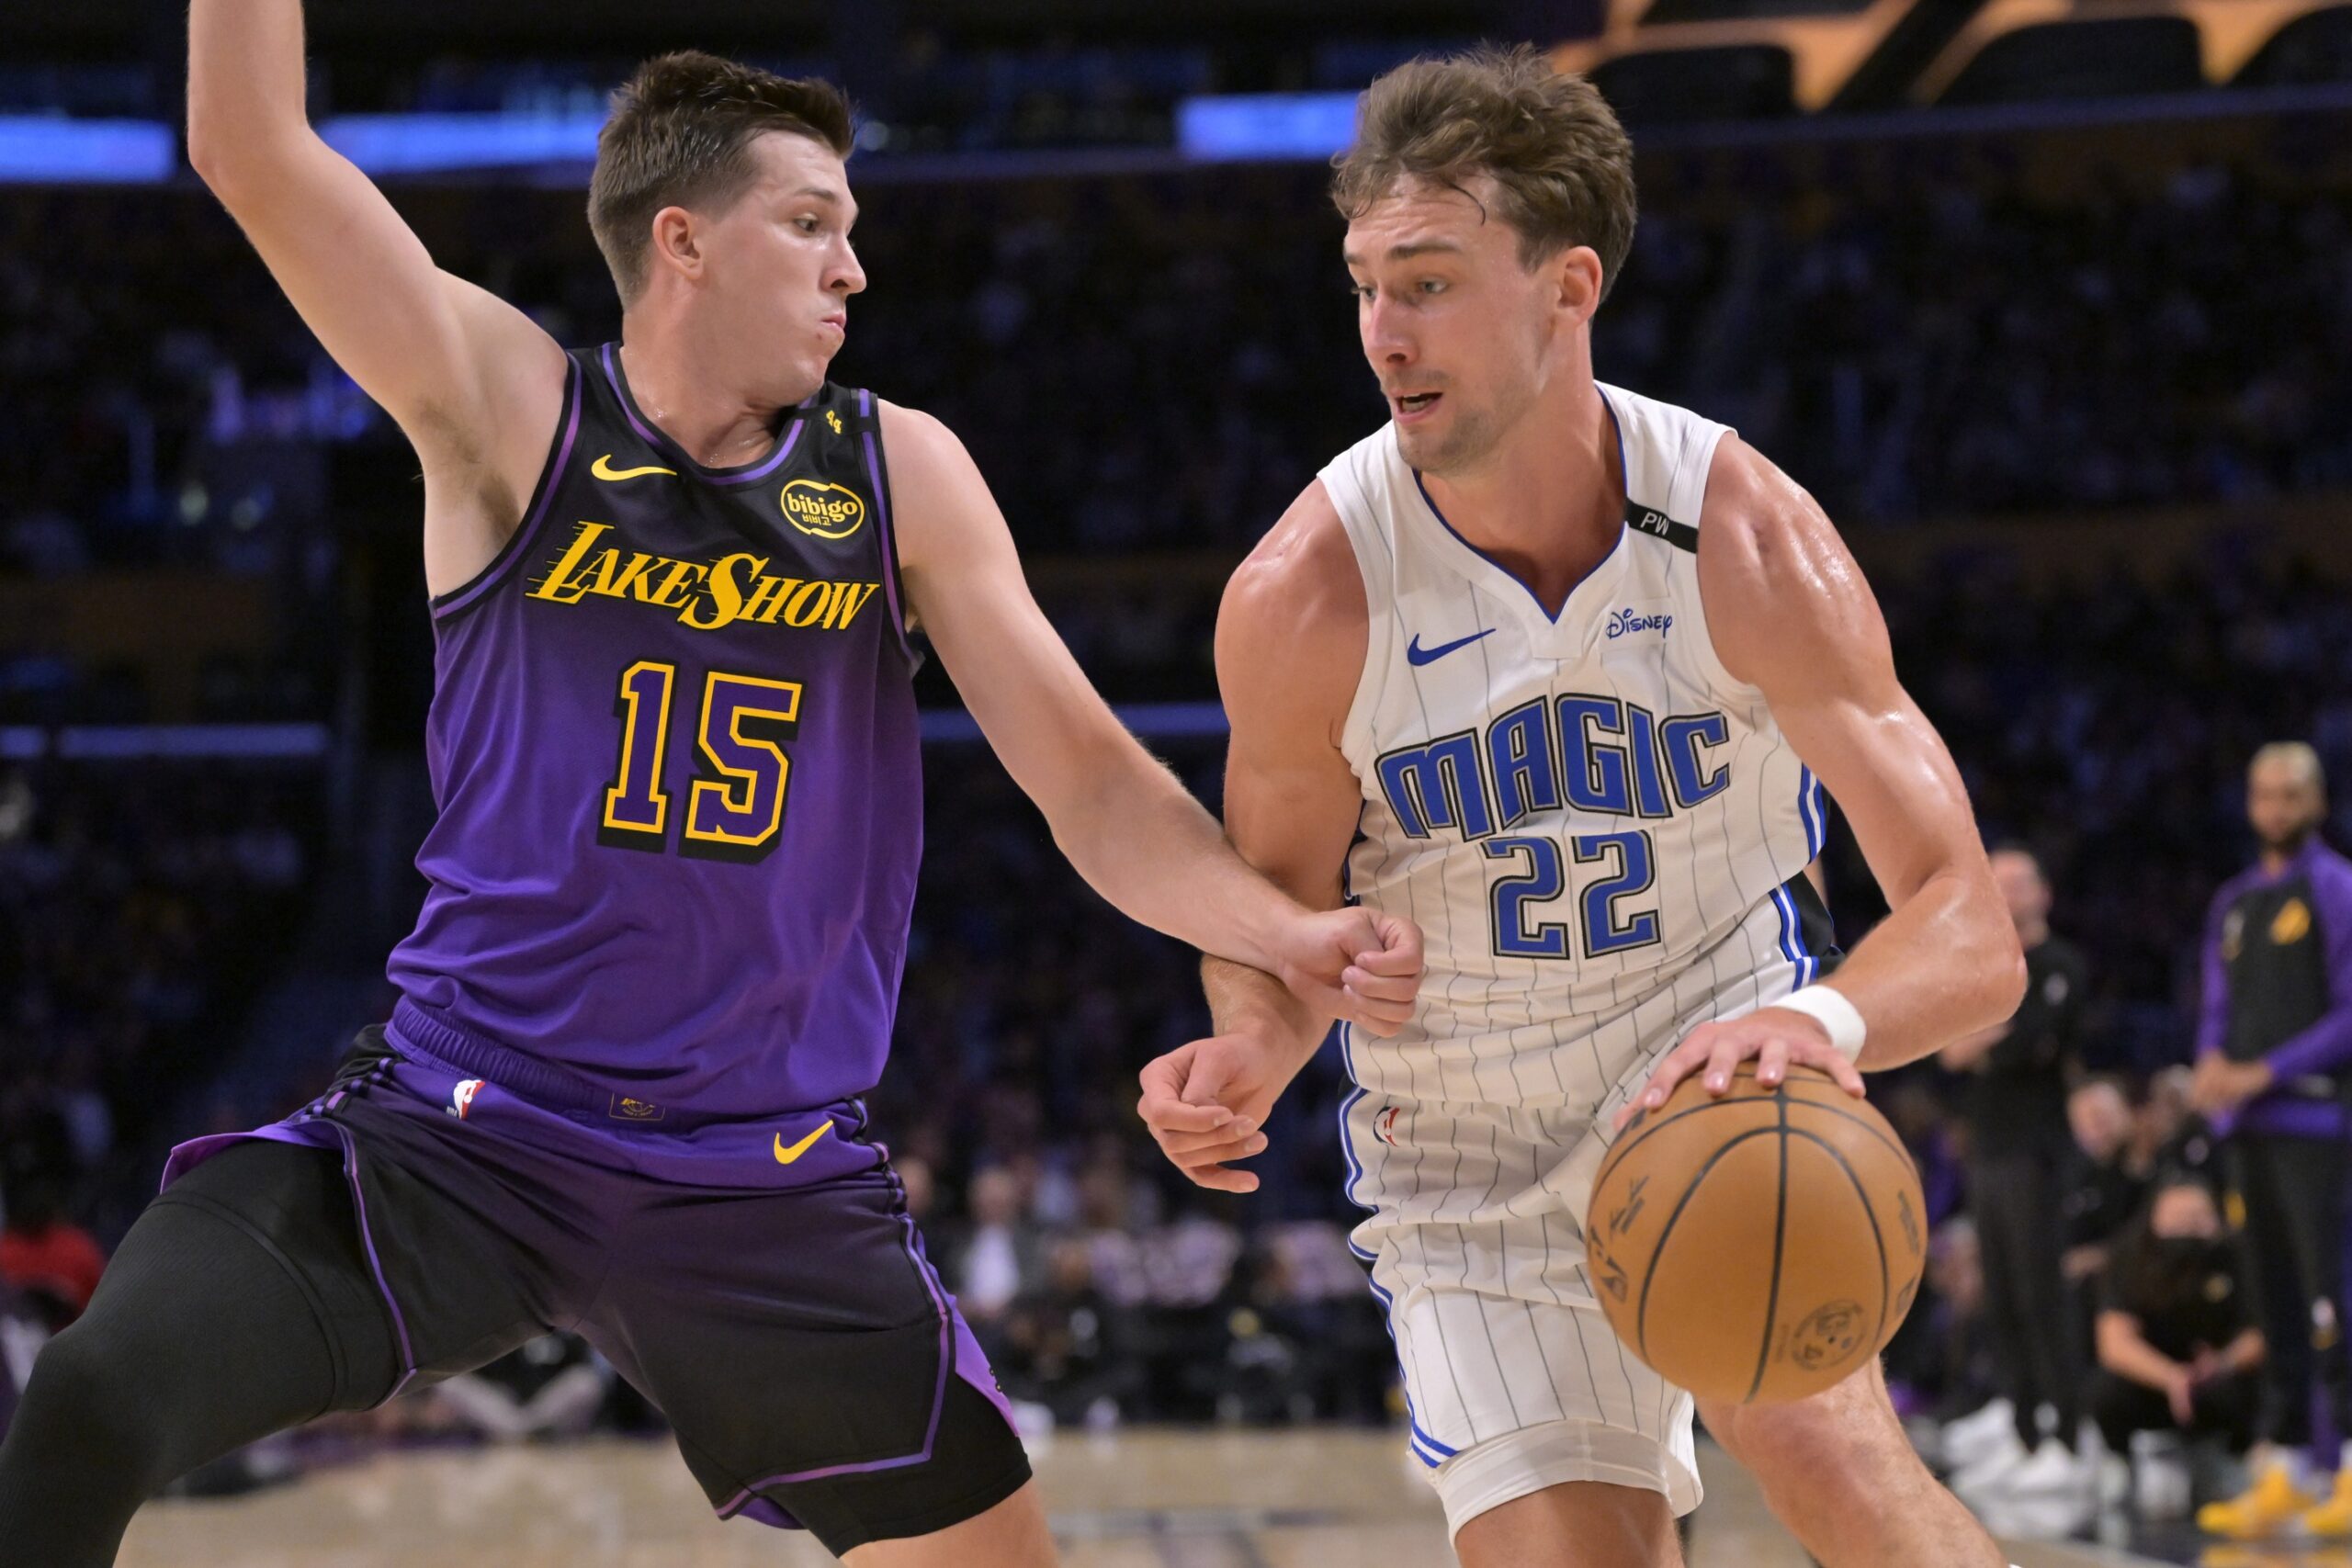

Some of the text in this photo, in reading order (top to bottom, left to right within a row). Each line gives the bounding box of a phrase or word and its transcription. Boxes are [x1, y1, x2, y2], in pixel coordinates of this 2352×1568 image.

[786, 492, 858, 523] bibigo
[1640, 511, 1670, 536] PW
[526, 521, 880, 630] LAKESHOW
[602, 660, 803, 850] 15
[1374, 693, 1731, 842] MAGIC
[1480, 829, 1662, 961] 22
